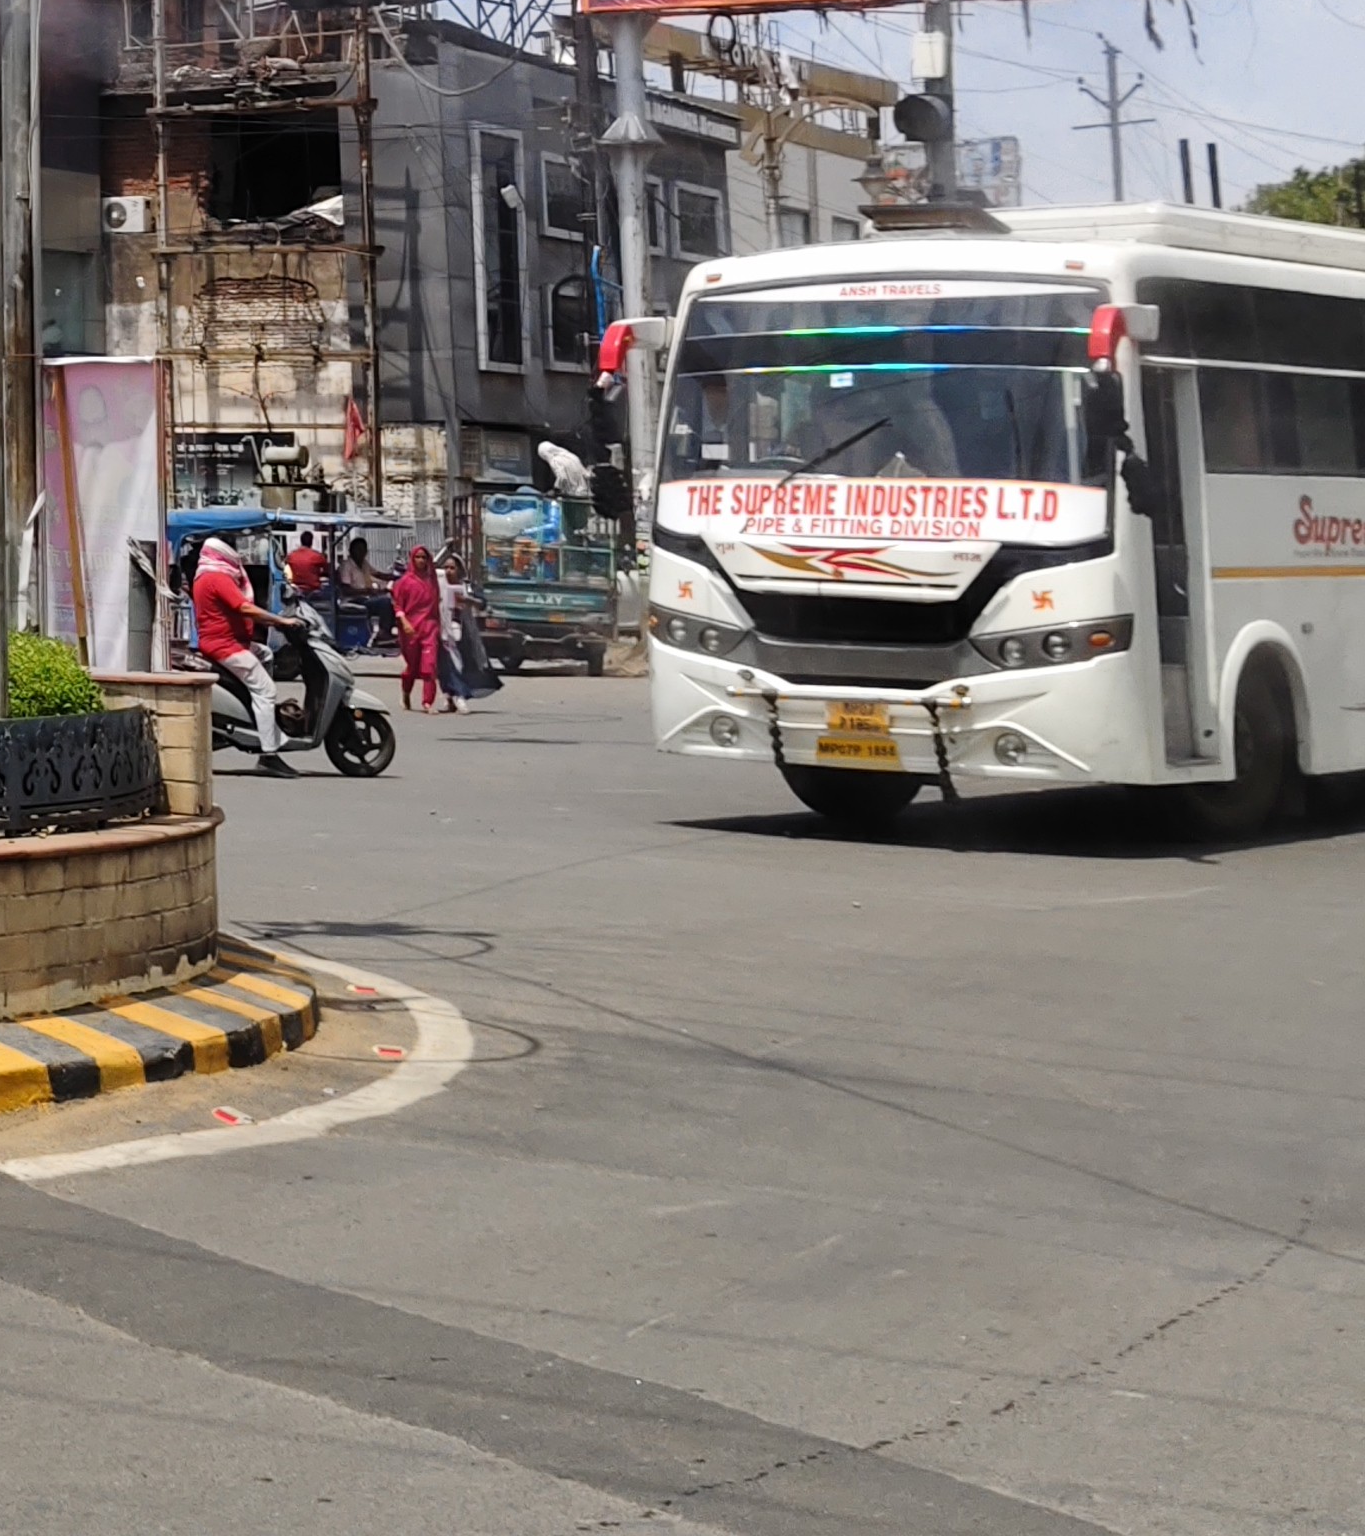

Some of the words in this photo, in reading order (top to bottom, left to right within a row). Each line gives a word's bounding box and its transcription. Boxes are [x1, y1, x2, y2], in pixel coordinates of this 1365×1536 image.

[839, 285, 877, 296] ANSH
[882, 283, 941, 295] TRAVELS
[687, 484, 724, 516] THE
[731, 483, 837, 515] SUPREME
[846, 484, 988, 519] INDUSTRIES
[996, 487, 1058, 522] L.T.D
[745, 516, 785, 534] PIPE
[792, 517, 803, 533] &
[810, 517, 883, 535] FITTING
[890, 519, 981, 537] DIVISION
[1293, 494, 1365, 556] Supre
